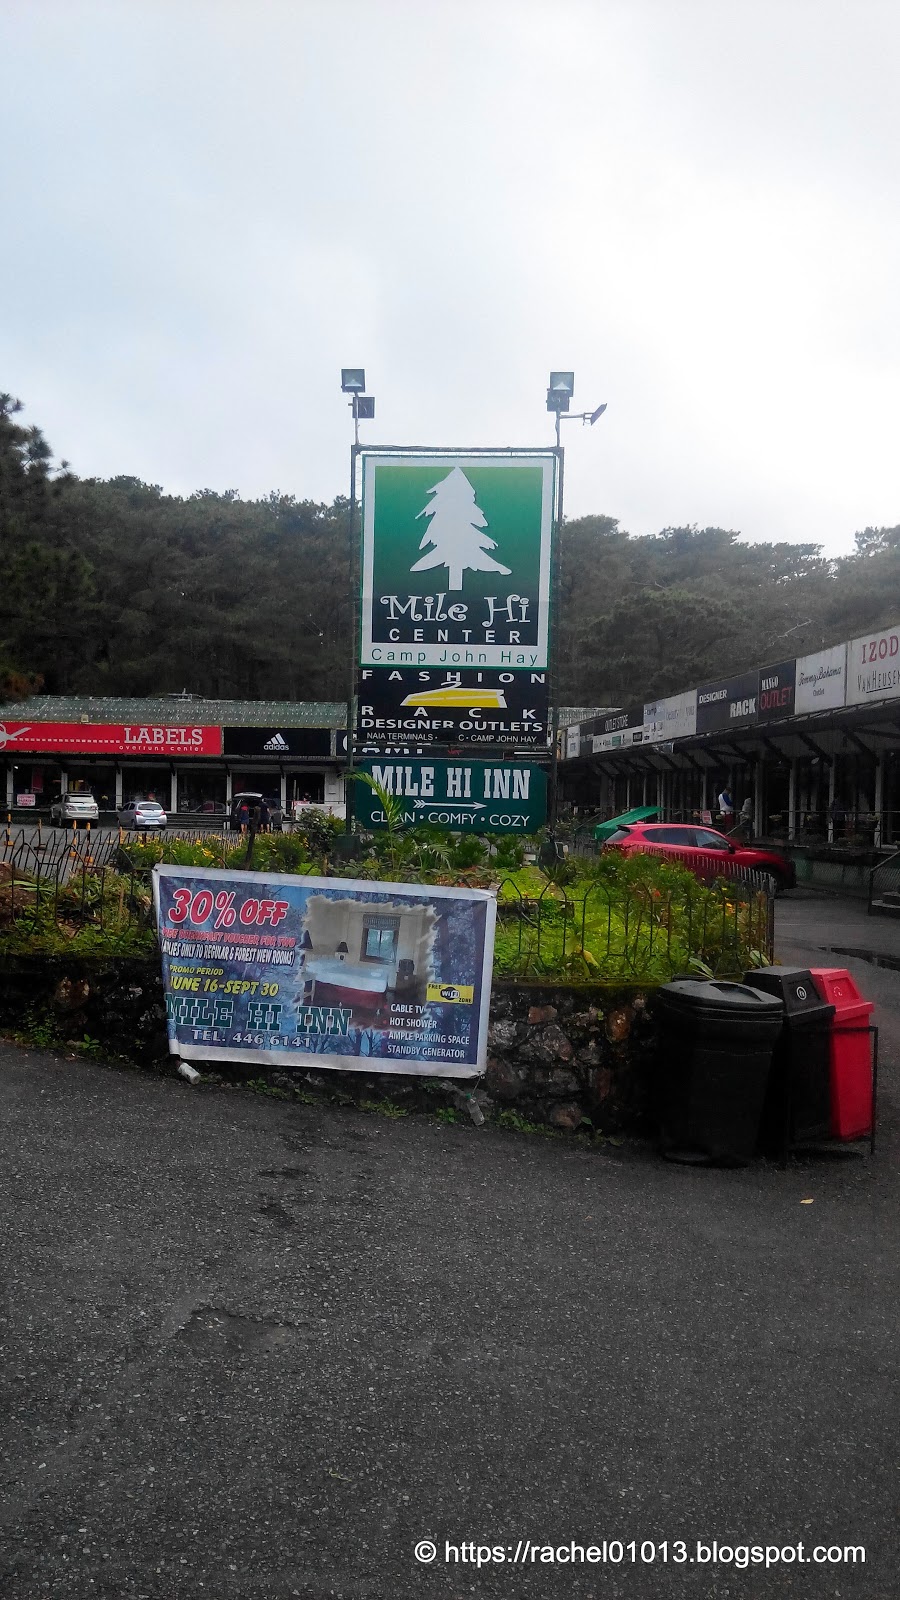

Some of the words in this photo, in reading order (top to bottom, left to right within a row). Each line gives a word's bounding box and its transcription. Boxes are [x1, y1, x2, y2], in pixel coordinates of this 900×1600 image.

[380, 593, 469, 622] Mile
[481, 594, 531, 627] Hi
[389, 628, 521, 644] CENTER
[371, 648, 427, 665] Camp
[439, 649, 487, 664] John
[501, 650, 538, 667] Hay
[861, 635, 899, 664] IZOD
[362, 670, 546, 684] FASHION
[699, 689, 728, 704] DESIGNER
[760, 686, 793, 710] OUTLET
[361, 706, 536, 720] RACK
[729, 698, 757, 718] RACK
[361, 718, 454, 730] DESIGNER
[459, 720, 544, 733] OUTLETS
[124, 728, 203, 745] LABELS
[367, 732, 387, 740] NAIA
[387, 733, 433, 741] TERMINALS
[496, 735, 519, 743] JOHN
[371, 765, 435, 797] MILE
[446, 767, 472, 798] HI
[483, 768, 531, 800] INN
[371, 811, 416, 823] CLAN
[428, 812, 477, 825] COMFY
[489, 814, 530, 827] COZY
[168, 888, 237, 929] 30%
[240, 898, 290, 927] OFF
[260, 935, 277, 947] FOR
[278, 936, 297, 948] TWO
[181, 942, 197, 958] ONLY
[196, 943, 204, 959] TO
[203, 944, 230, 961] REGULAR
[234, 946, 258, 962] FOREST
[256, 948, 273, 964] VIEW
[170, 964, 195, 974] PROMO
[196, 967, 224, 976] PERIOD
[204, 978, 259, 996] 16-SEPT
[260, 983, 280, 997] 30
[164, 992, 234, 1029] MILE
[246, 1002, 282, 1031] HI
[296, 1006, 352, 1037] INN
[390, 1004, 414, 1014] CABLE
[415, 1005, 425, 1014] TV
[389, 1017, 405, 1026] HOT
[406, 1018, 438, 1029] SHOWER
[191, 1029, 226, 1041] TEL.
[232, 1033, 264, 1045] 446
[270, 1035, 311, 1048] 6141
[388, 1031, 414, 1041] AMPLE
[414, 1033, 446, 1043] PARKING
[447, 1035, 470, 1045] SPACE
[387, 1045, 421, 1055] STANDBY
[422, 1047, 466, 1058] GENERATOR
